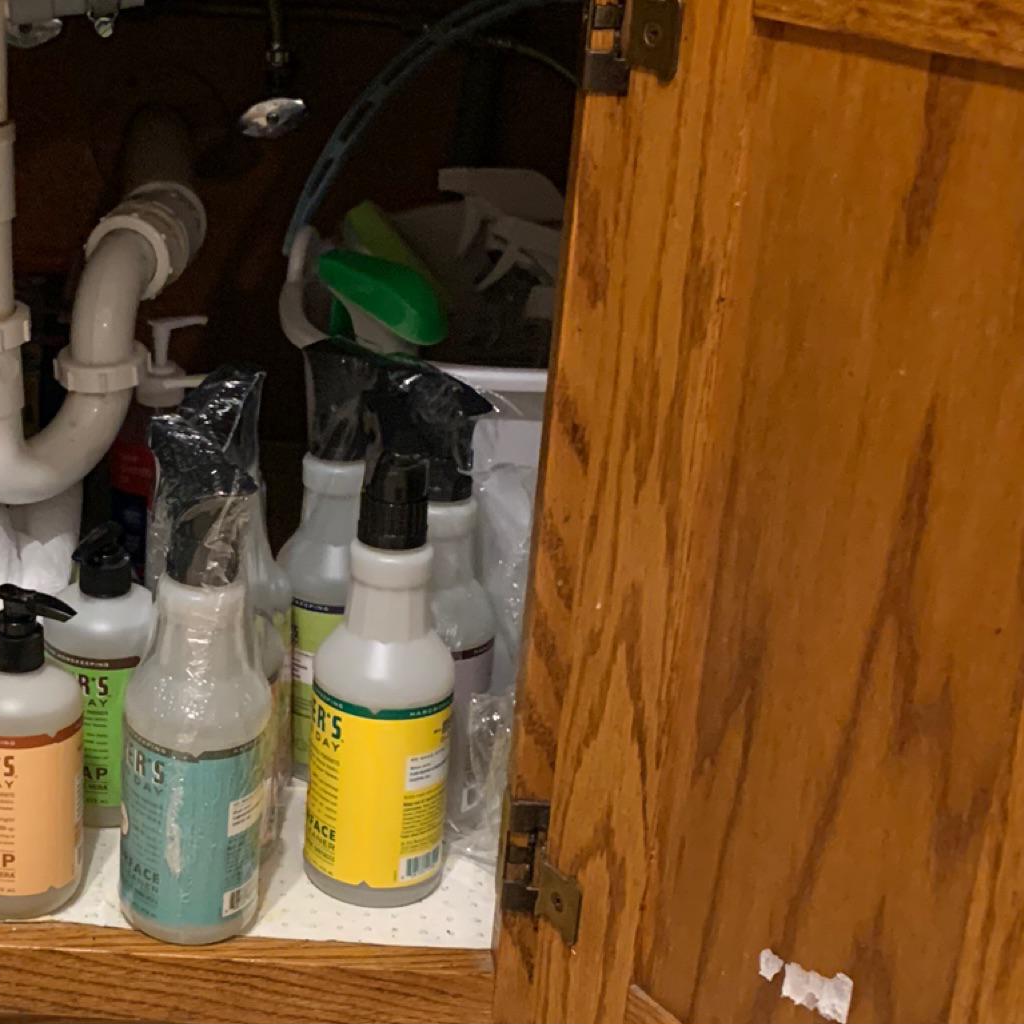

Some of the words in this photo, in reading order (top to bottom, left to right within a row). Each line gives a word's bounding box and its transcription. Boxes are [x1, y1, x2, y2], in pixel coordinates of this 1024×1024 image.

[78, 673, 109, 696] R'S
[87, 699, 108, 707] AY
[126, 742, 166, 785] ER'S
[83, 767, 108, 780] AP
